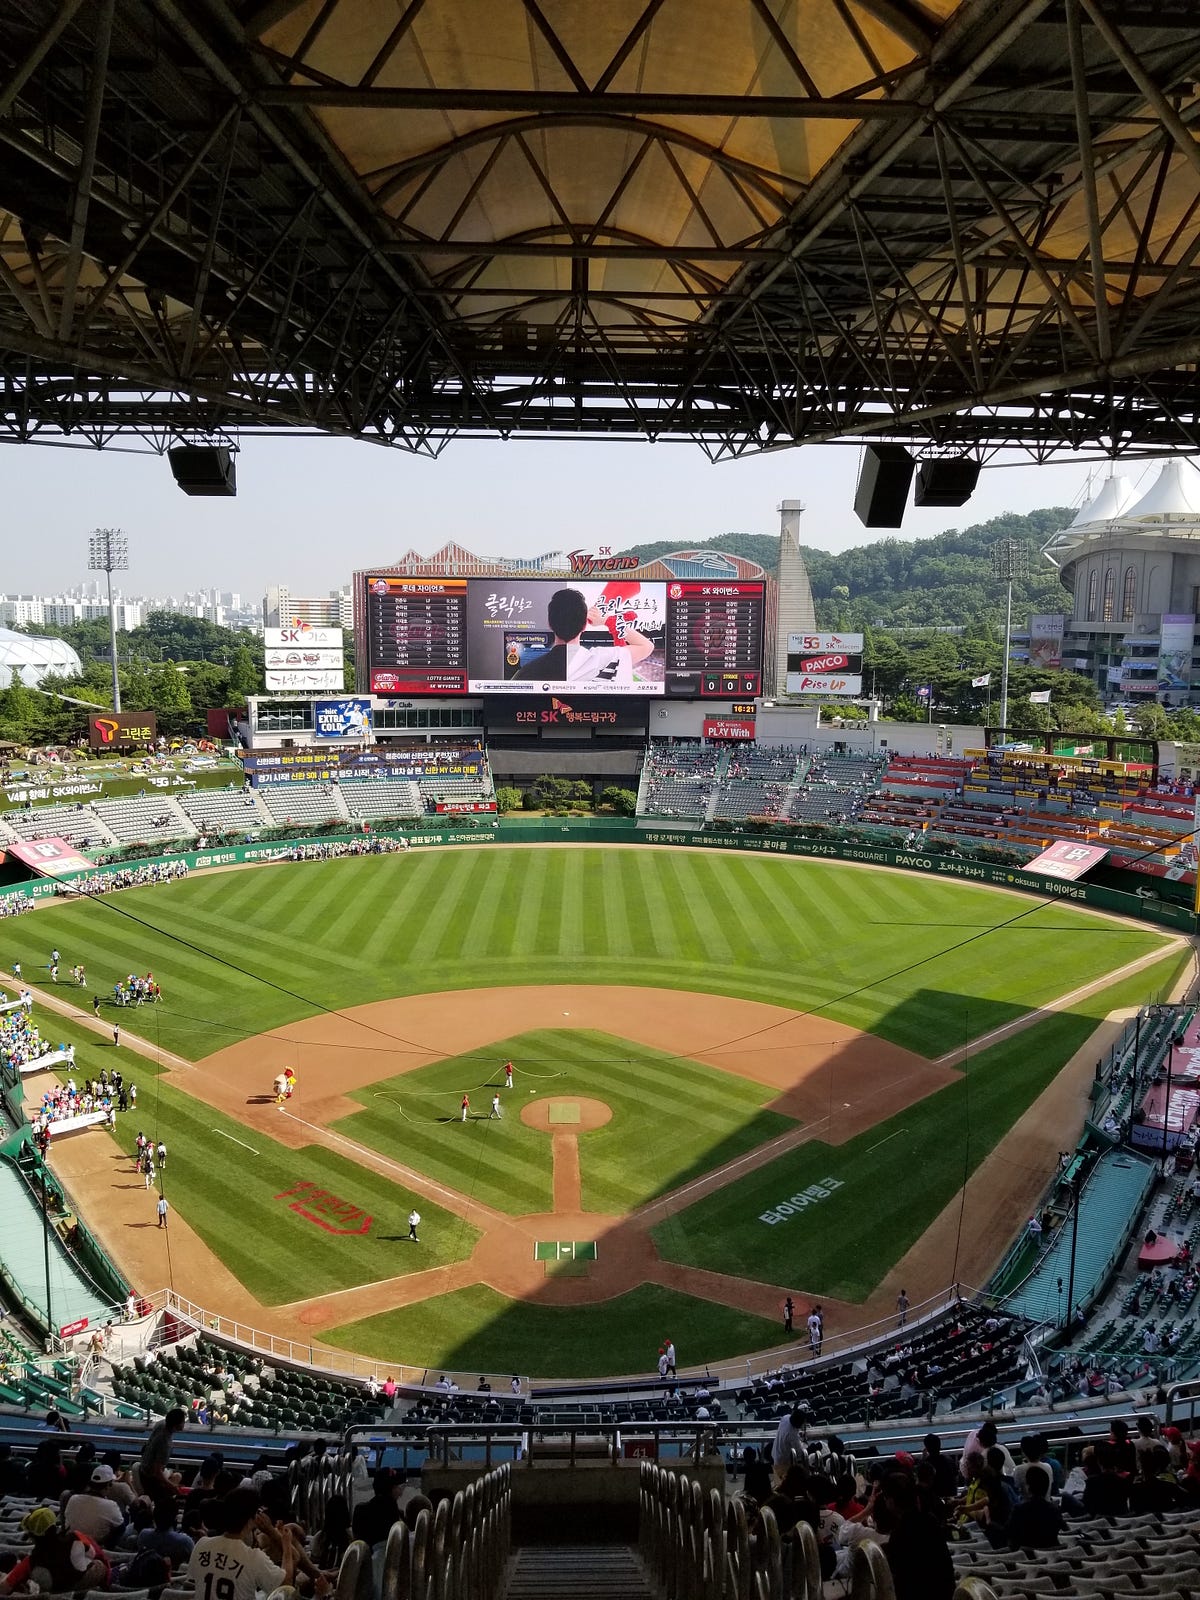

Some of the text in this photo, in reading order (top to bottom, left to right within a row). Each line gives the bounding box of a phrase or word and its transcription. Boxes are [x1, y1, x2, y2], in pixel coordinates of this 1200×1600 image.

[599, 547, 611, 555] SK
[567, 549, 640, 576] Wyverns
[702, 587, 739, 596] SK 와이번스
[281, 630, 299, 642] SK
[803, 636, 820, 649] 5G
[806, 656, 843, 672] PAYCO
[708, 681, 753, 691] 0 0 0
[801, 677, 828, 691] Rise
[399, 701, 413, 709] Club
[734, 705, 755, 713] 16:21
[319, 715, 344, 723] EXTRA
[516, 711, 616, 723] 인천 SK 행복드림구장
[322, 723, 342, 732] COLD
[708, 727, 750, 738] PLAY With
[120, 727, 151, 741] 그린존
[53, 783, 103, 797] SK와이번스!
[896, 854, 931, 869] PAYCO
[1014, 877, 1040, 889] oksusu
[758, 1177, 845, 1225] 타이어뱅크
[632, 1447, 648, 1459] 41
[198, 1551, 244, 1579] 정진기
